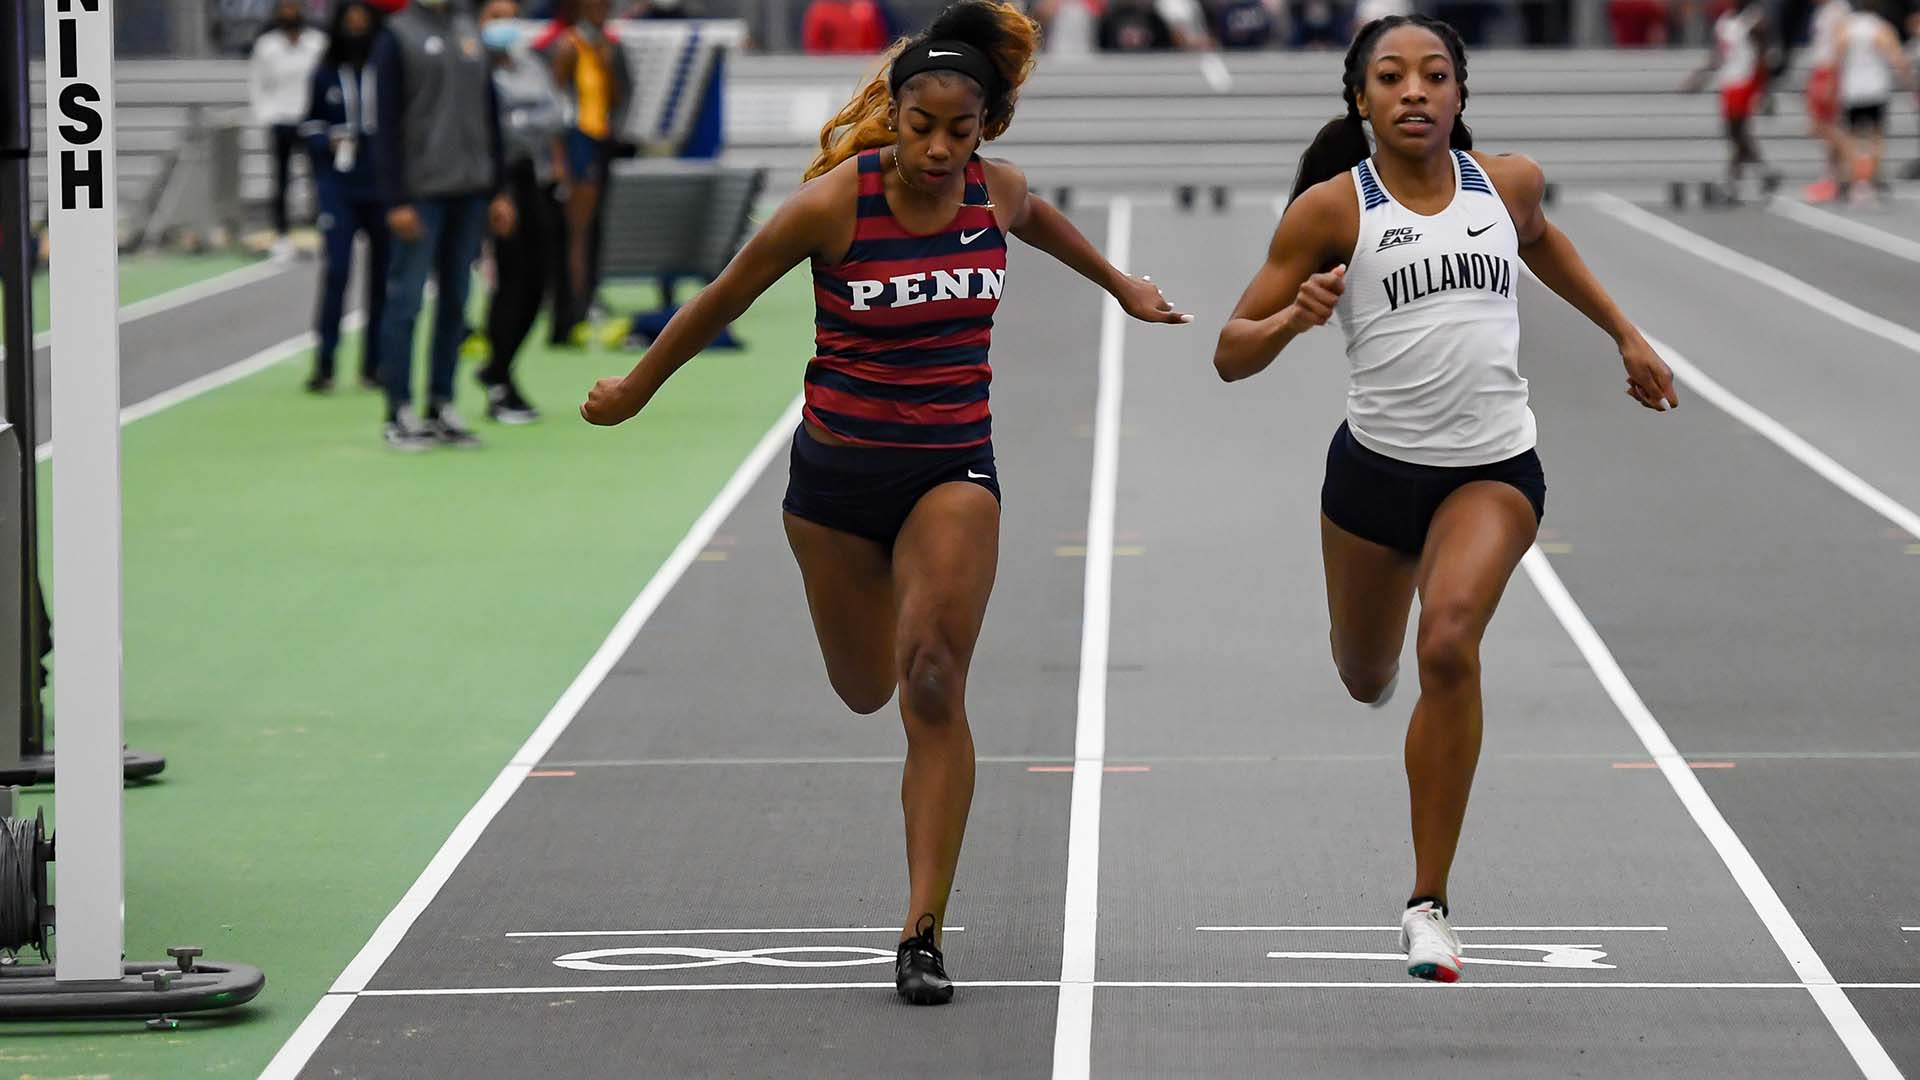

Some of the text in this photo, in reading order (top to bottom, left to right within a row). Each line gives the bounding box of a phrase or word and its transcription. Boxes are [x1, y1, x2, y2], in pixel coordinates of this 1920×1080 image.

[57, 0, 103, 210] ISH
[1378, 233, 1423, 247] EAST
[1383, 226, 1414, 238] BIG
[847, 267, 1006, 311] PENN
[1382, 252, 1510, 312] VILLANOVA
